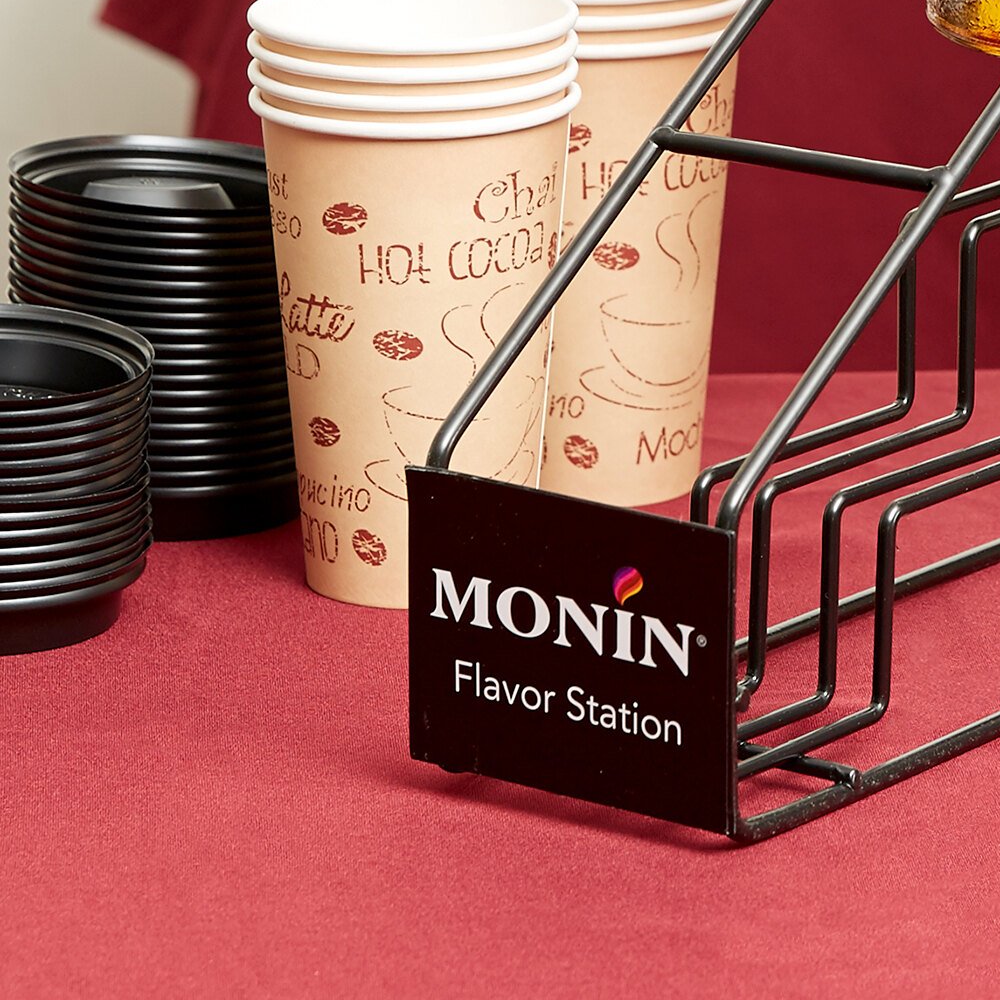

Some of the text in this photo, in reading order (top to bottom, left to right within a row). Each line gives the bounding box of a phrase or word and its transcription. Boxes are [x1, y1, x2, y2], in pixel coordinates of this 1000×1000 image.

[473, 161, 558, 224] Chai
[454, 659, 683, 746] Flavor Station
